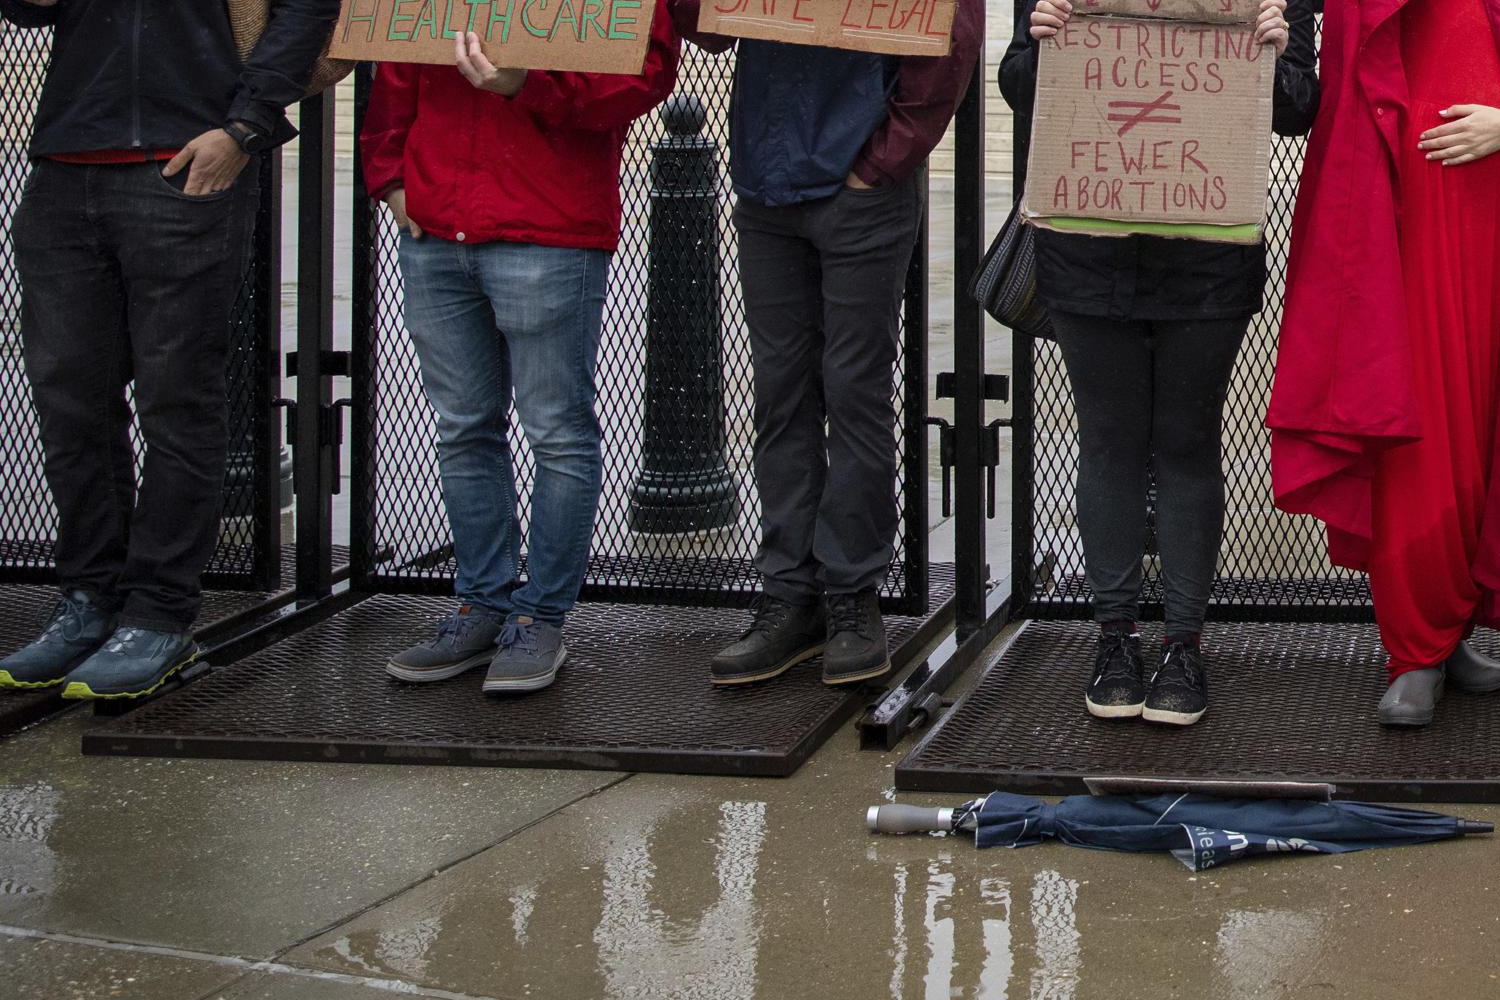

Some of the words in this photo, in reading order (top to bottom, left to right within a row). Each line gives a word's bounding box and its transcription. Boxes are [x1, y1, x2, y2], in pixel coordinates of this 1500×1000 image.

[1085, 56, 1224, 93] ACCESS
[1070, 138, 1209, 175] FEWER
[1053, 175, 1227, 212] ABORTIONS
